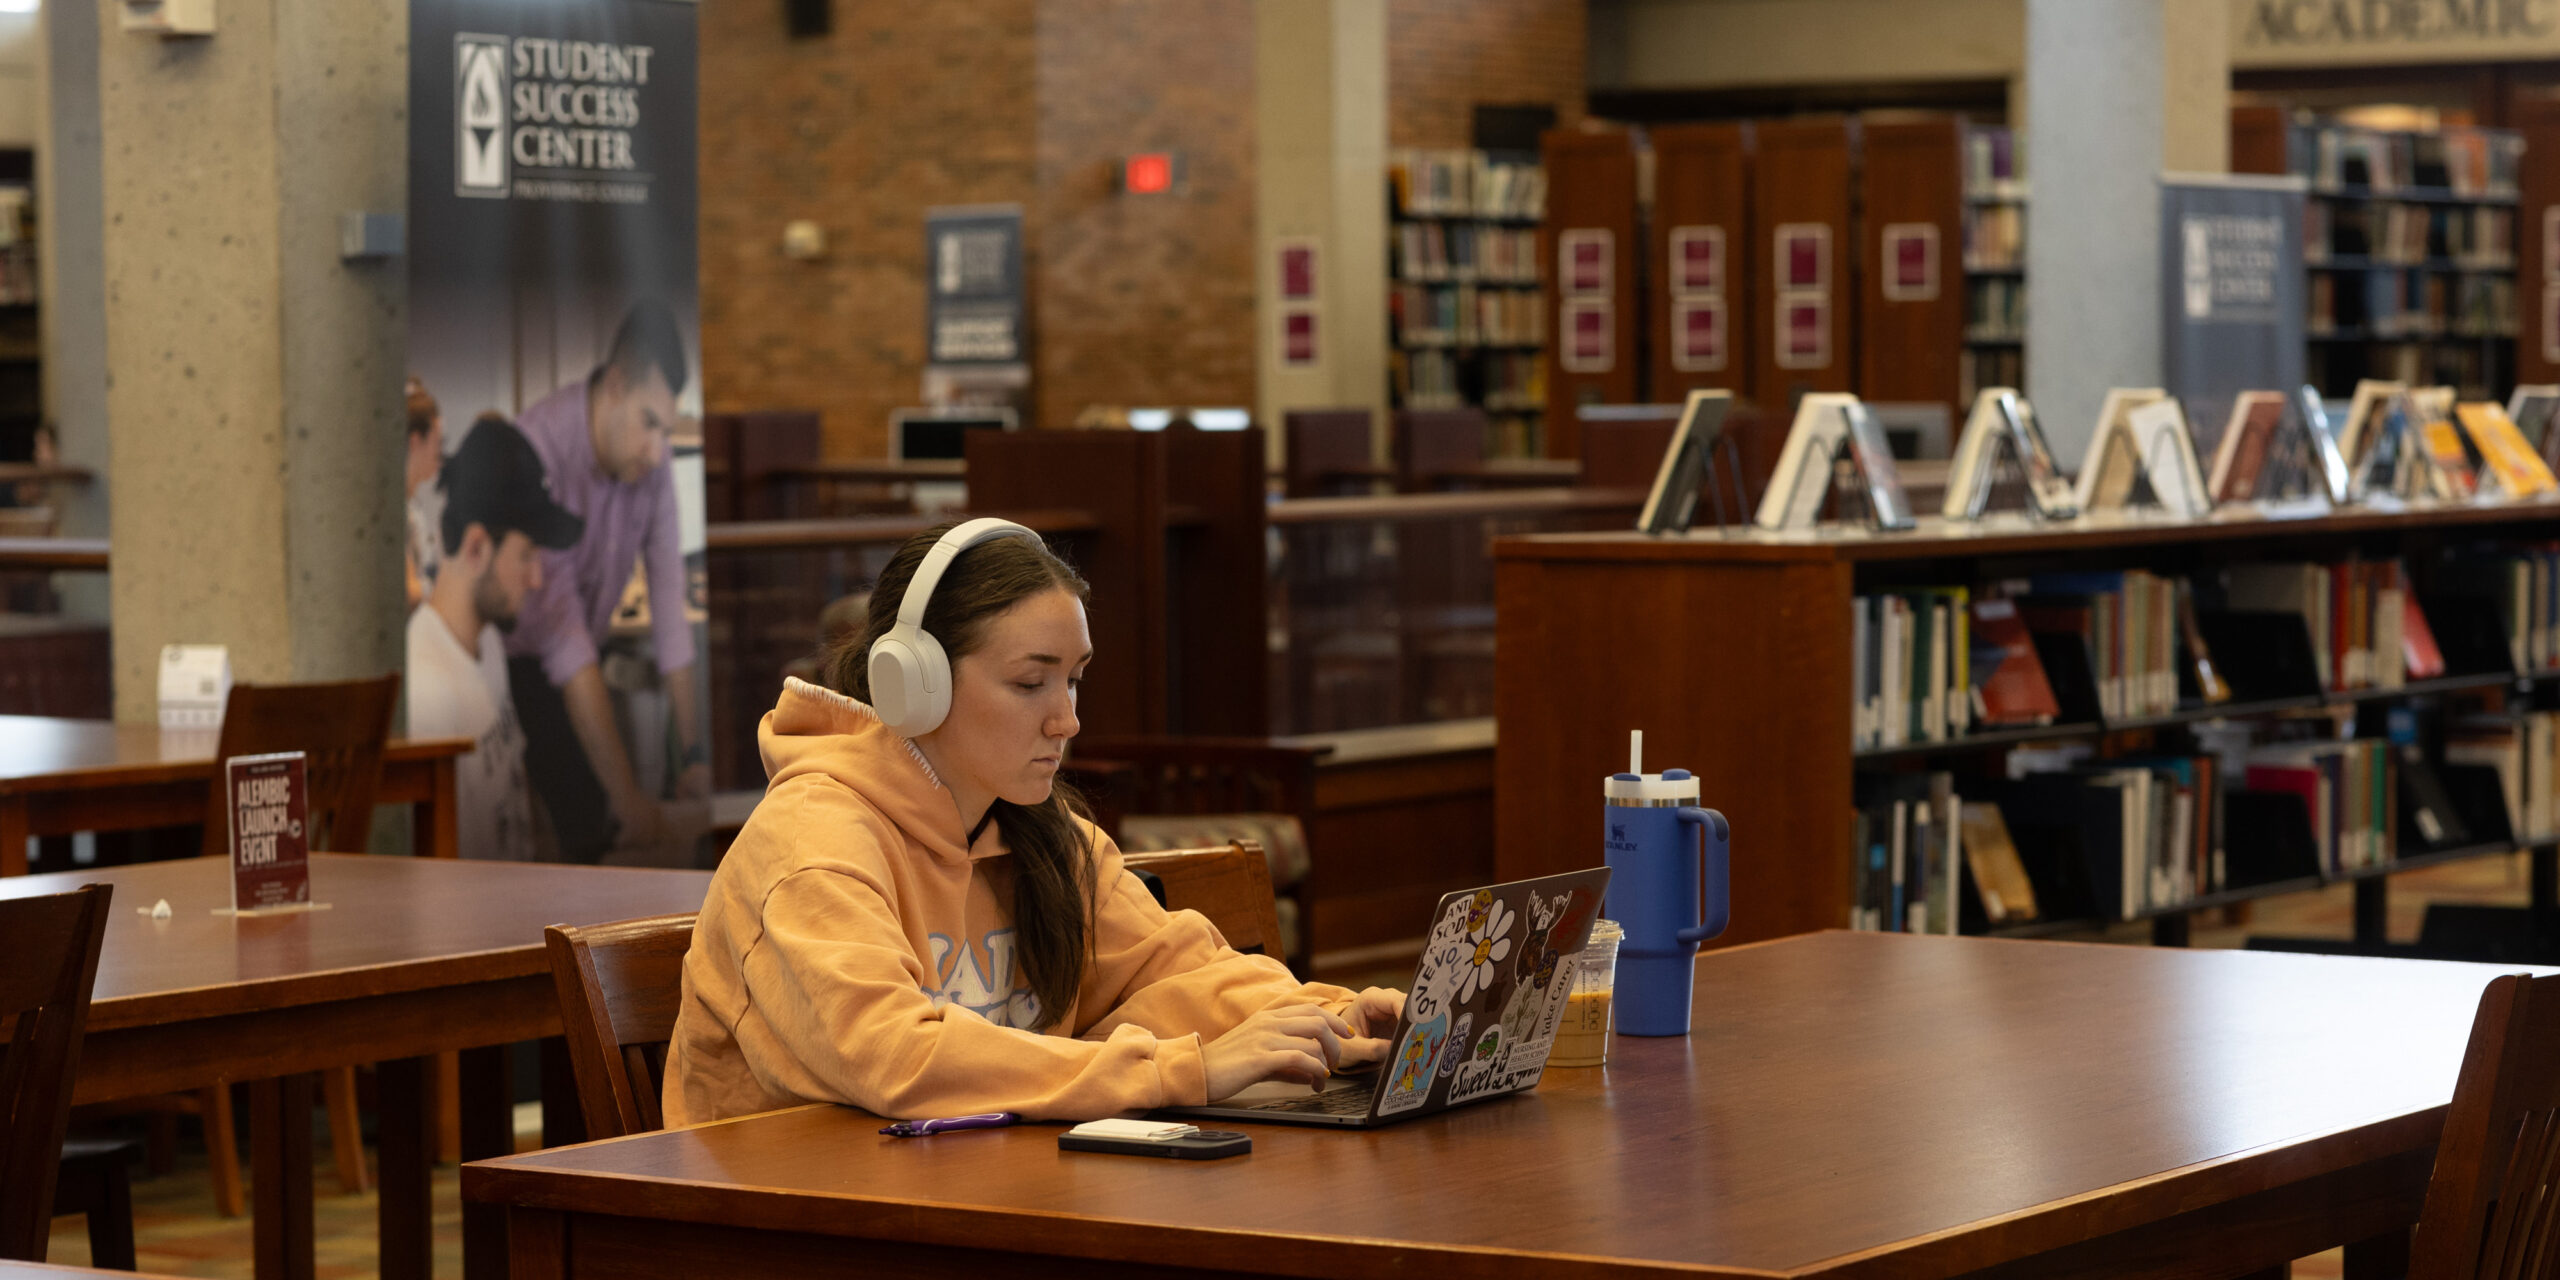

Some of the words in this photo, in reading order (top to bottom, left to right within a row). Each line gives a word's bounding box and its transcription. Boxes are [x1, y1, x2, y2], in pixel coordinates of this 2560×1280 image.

[512, 36, 654, 85] STUDENT
[512, 80, 640, 128] SUCCESS
[512, 125, 635, 170] CENTER
[238, 776, 290, 809] ALEMBIC
[239, 805, 288, 838] LAUNCH
[1434, 915, 1468, 941] SOD
[1447, 898, 1473, 920] ANTI
[1450, 1057, 1498, 1102] Sweet
